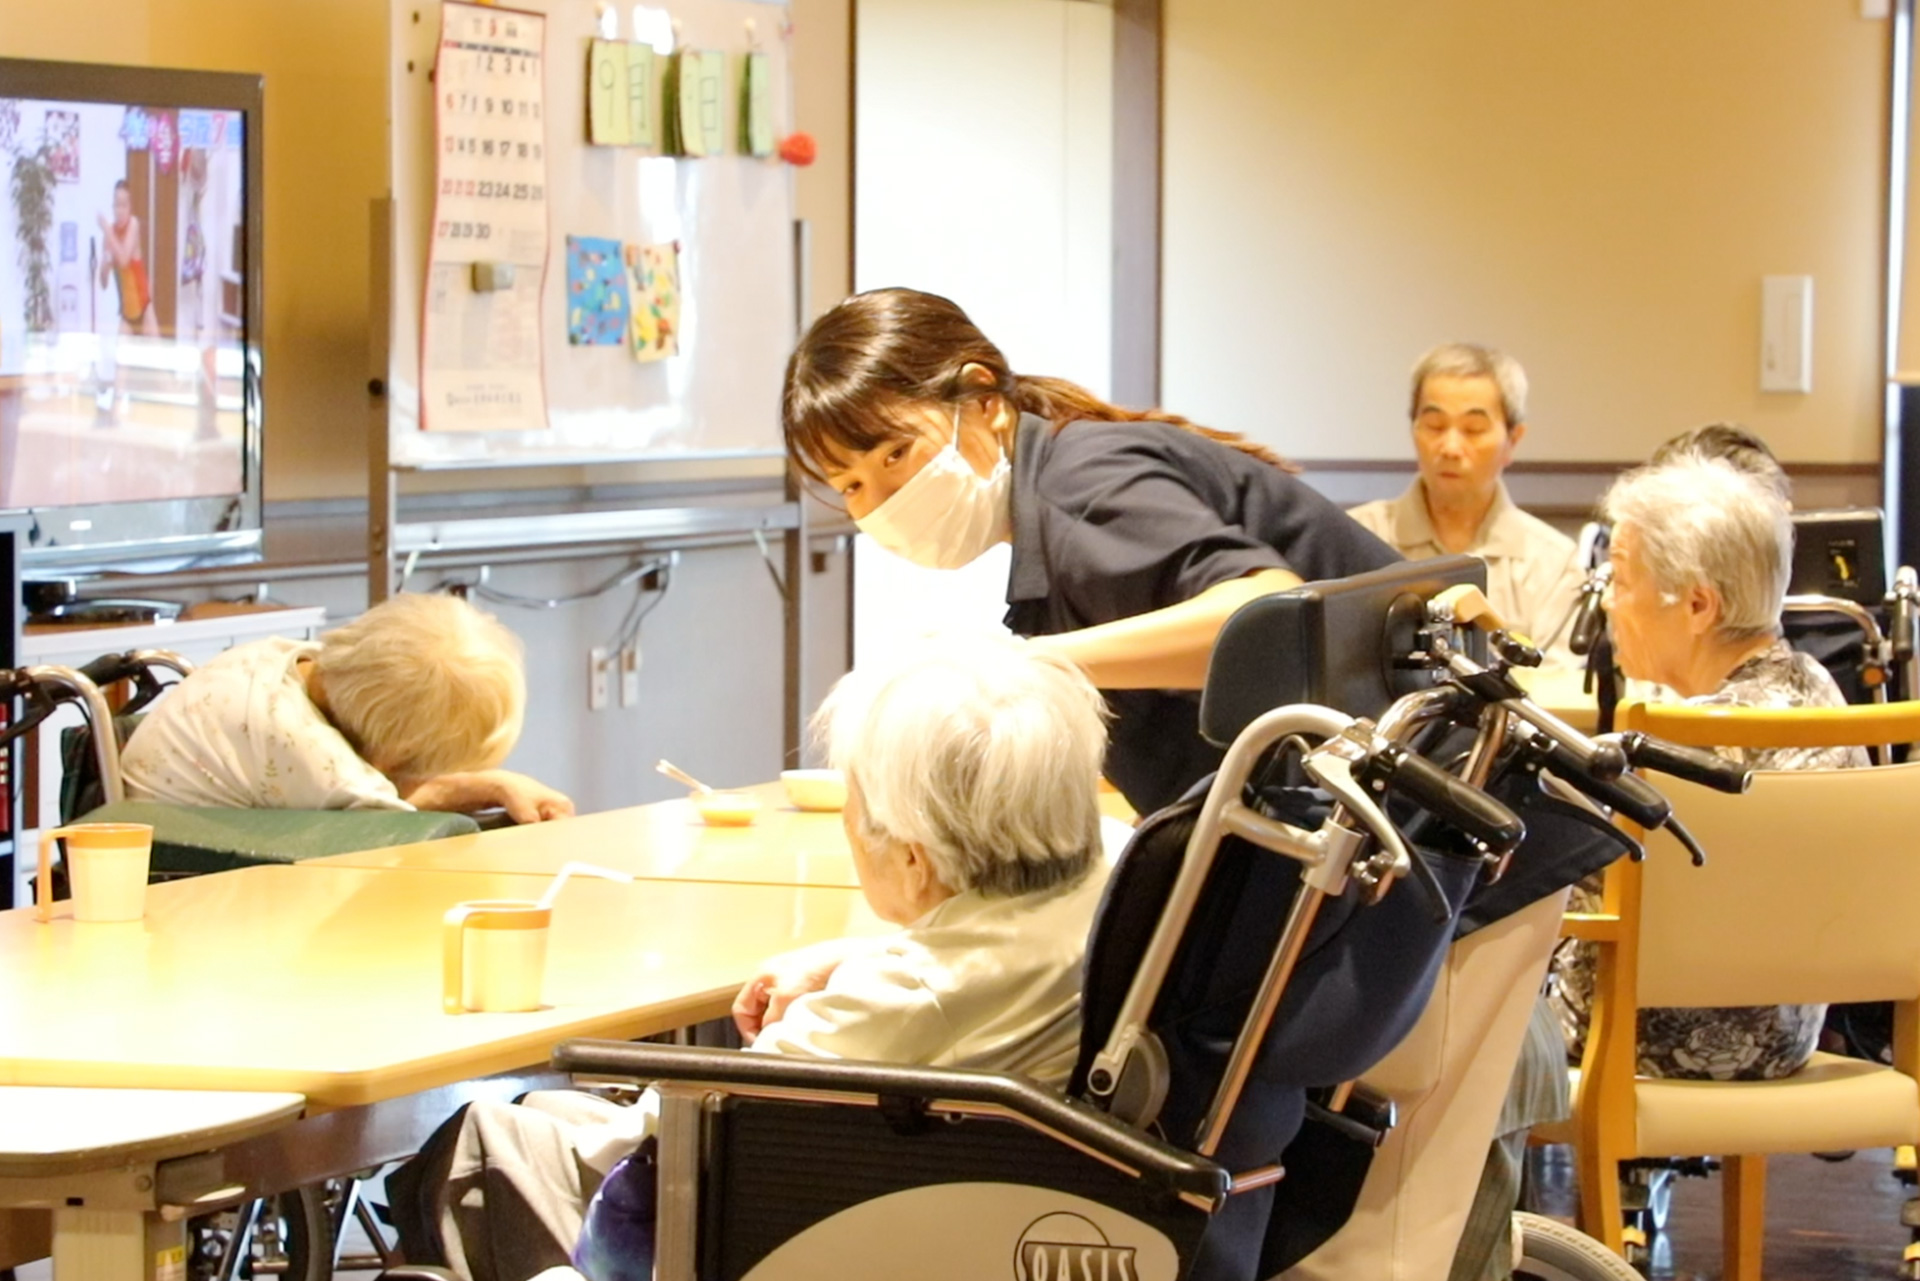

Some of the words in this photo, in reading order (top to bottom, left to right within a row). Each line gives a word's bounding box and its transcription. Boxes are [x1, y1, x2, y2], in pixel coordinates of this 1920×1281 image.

[486, 54, 494, 71] 2
[505, 56, 512, 74] 3
[485, 98, 493, 113] 9
[502, 99, 513, 114] 10
[500, 141, 510, 156] 17
[478, 181, 493, 197] 23
[495, 183, 510, 198] 24
[513, 184, 528, 199] 25
[475, 223, 490, 239] 30
[1032, 1245, 1130, 1281] OASIS
